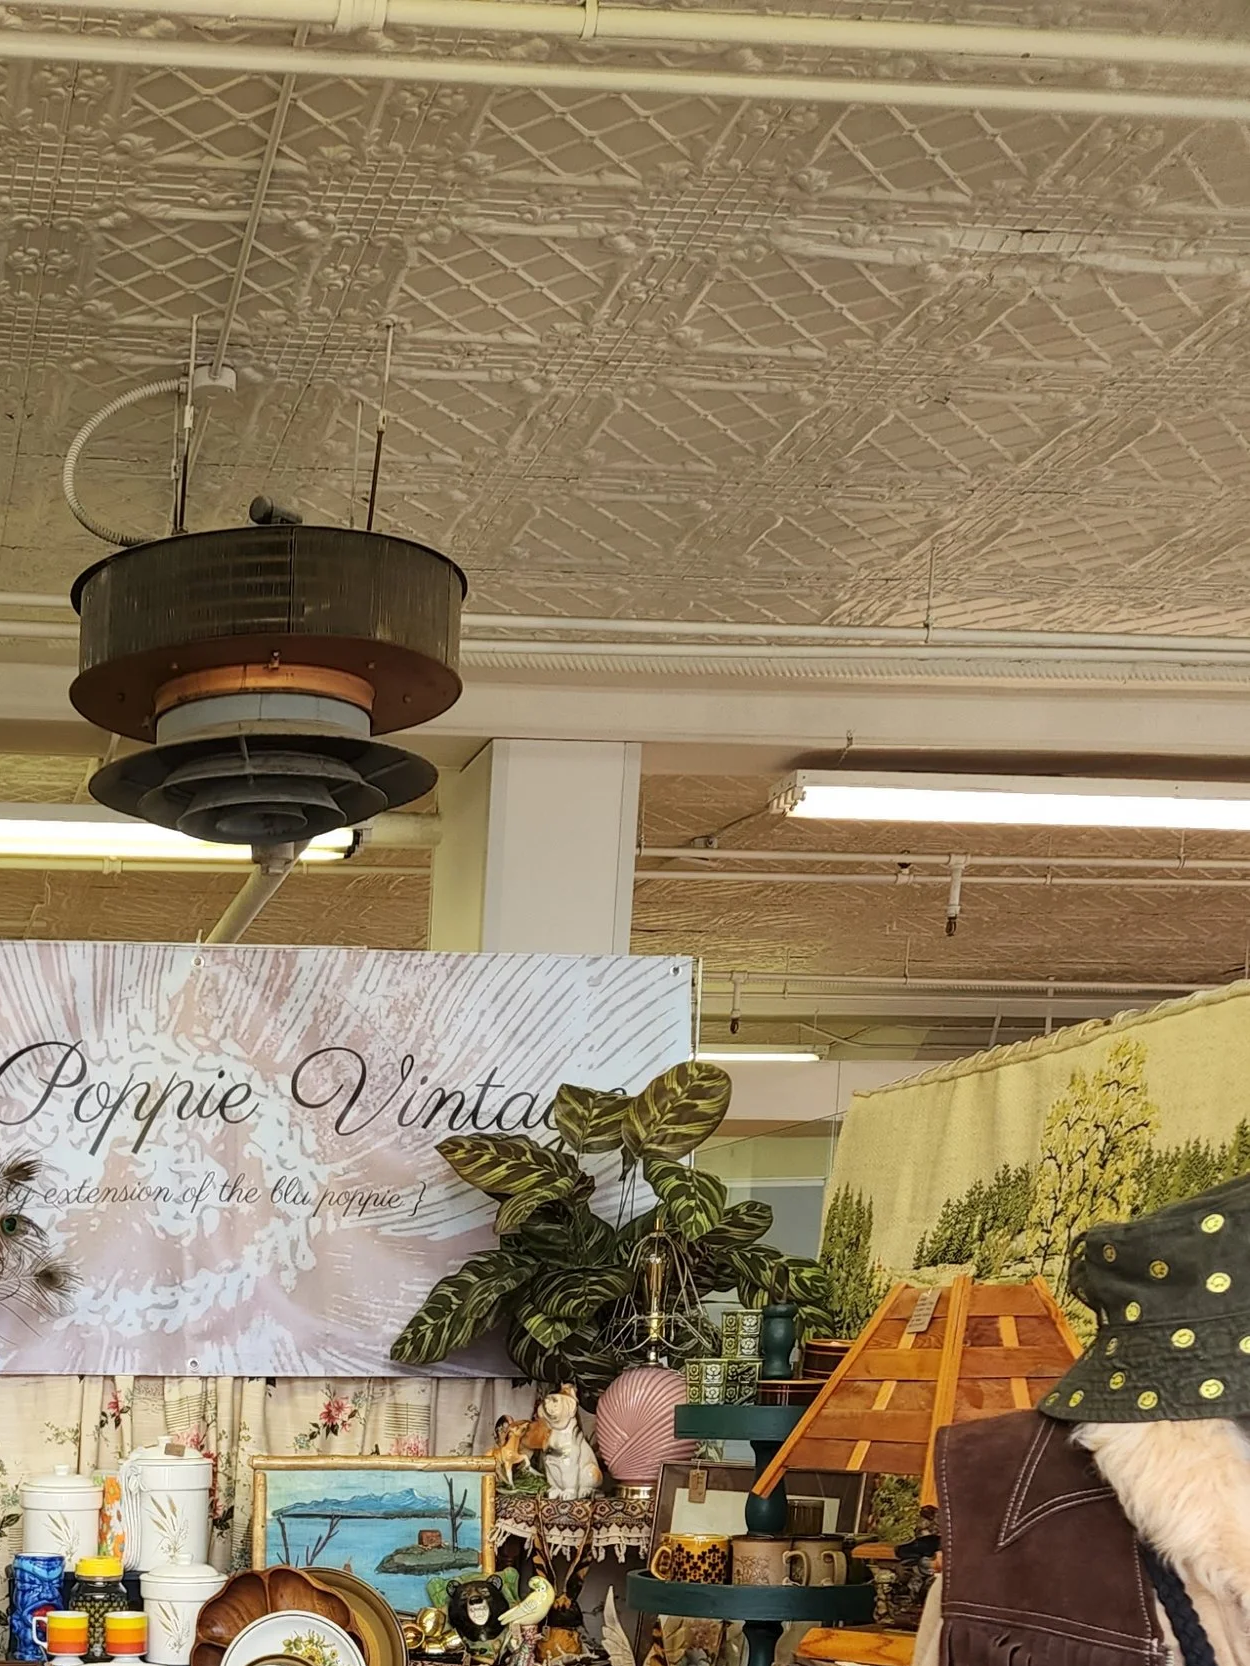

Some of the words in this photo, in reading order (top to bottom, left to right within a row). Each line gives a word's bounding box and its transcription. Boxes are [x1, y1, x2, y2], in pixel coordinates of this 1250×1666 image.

[290, 1046, 627, 1152] Vinta
[42, 1178, 174, 1205] extension
[182, 1170, 216, 1213] of
[218, 1172, 262, 1204] the
[270, 1175, 311, 1206] blu
[312, 1186, 404, 1218] poppie
